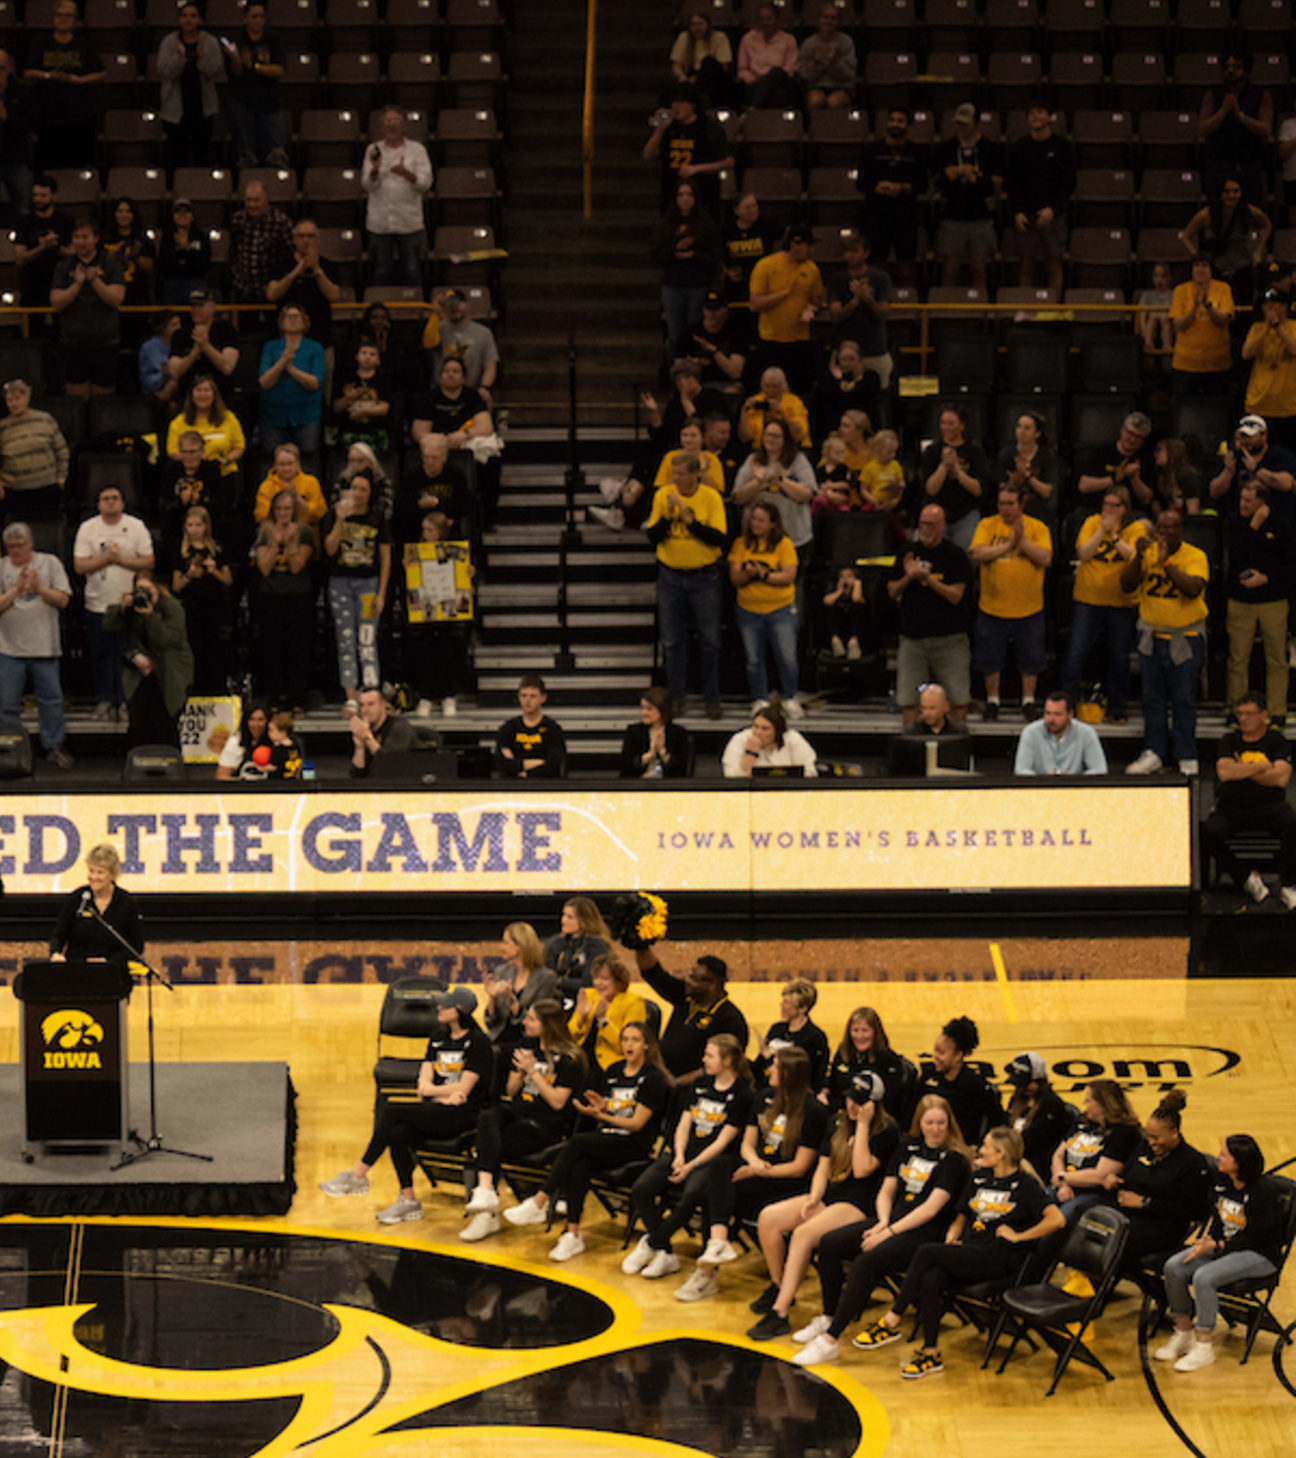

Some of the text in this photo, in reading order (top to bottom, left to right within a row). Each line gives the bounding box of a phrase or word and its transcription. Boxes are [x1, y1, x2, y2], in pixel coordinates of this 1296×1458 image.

[669, 150, 693, 168] 22
[1147, 573, 1178, 598] 22
[182, 732, 199, 744] 22
[107, 813, 274, 875] THE
[301, 811, 562, 874] GAME
[657, 828, 1093, 849] IOWA WOMEN'S BASKETBALL
[43, 1051, 102, 1069] IOWA
